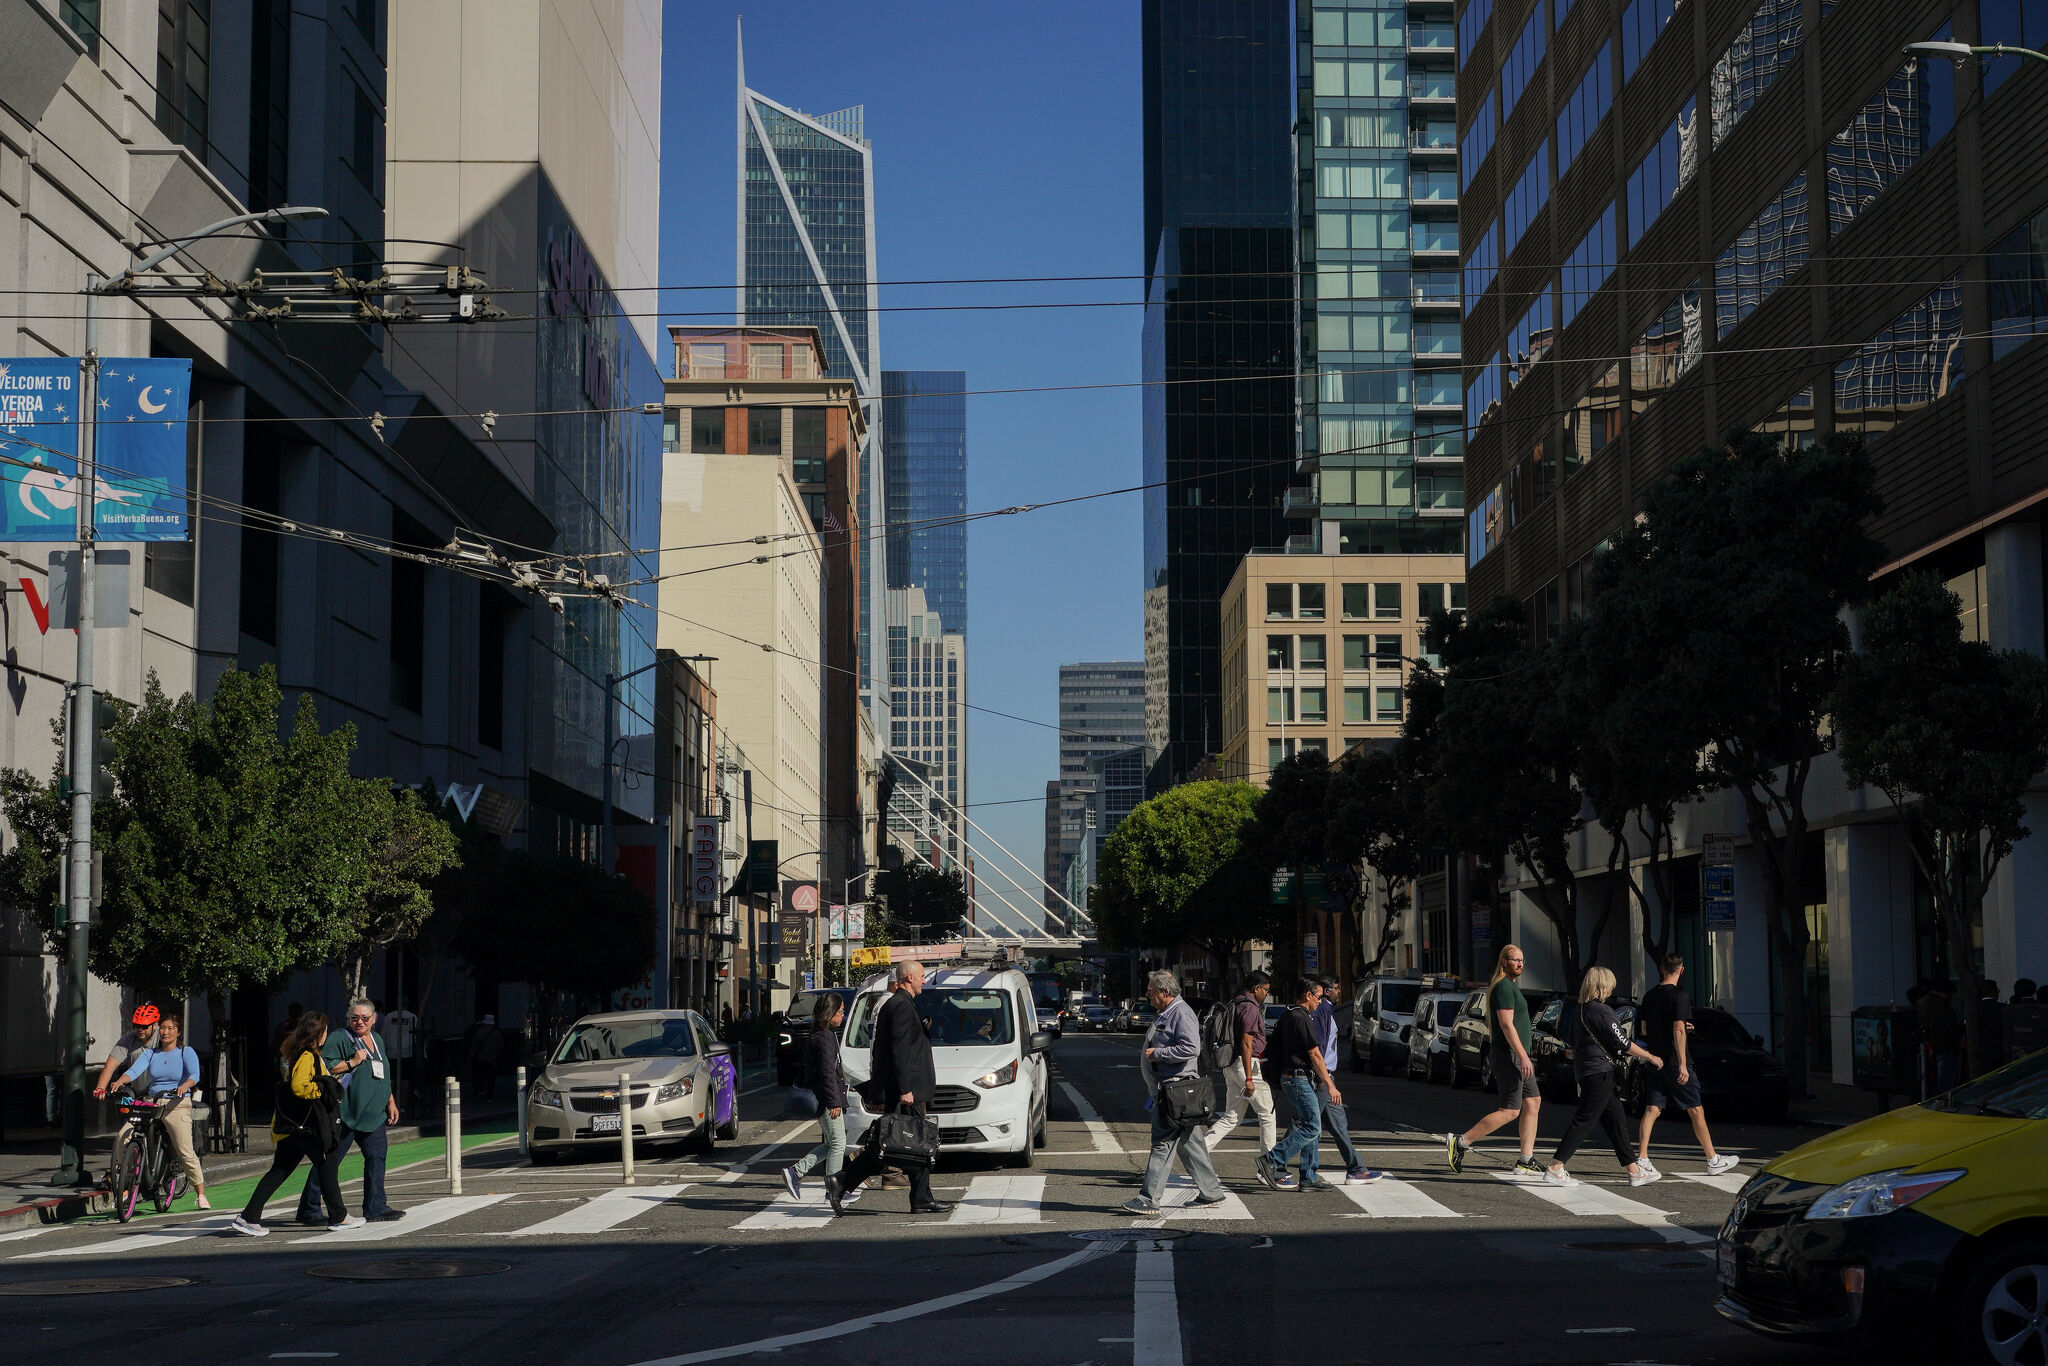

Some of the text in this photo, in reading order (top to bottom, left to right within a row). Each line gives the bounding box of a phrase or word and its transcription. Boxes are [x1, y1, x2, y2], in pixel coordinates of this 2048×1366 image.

[56, 376, 71, 391] TO
[1, 395, 44, 412] YERBA
[0, 411, 35, 434] UENA
[102, 514, 180, 525] VisitYerbaBuena.org
[696, 824, 715, 894] FANG
[621, 992, 652, 1011] for
